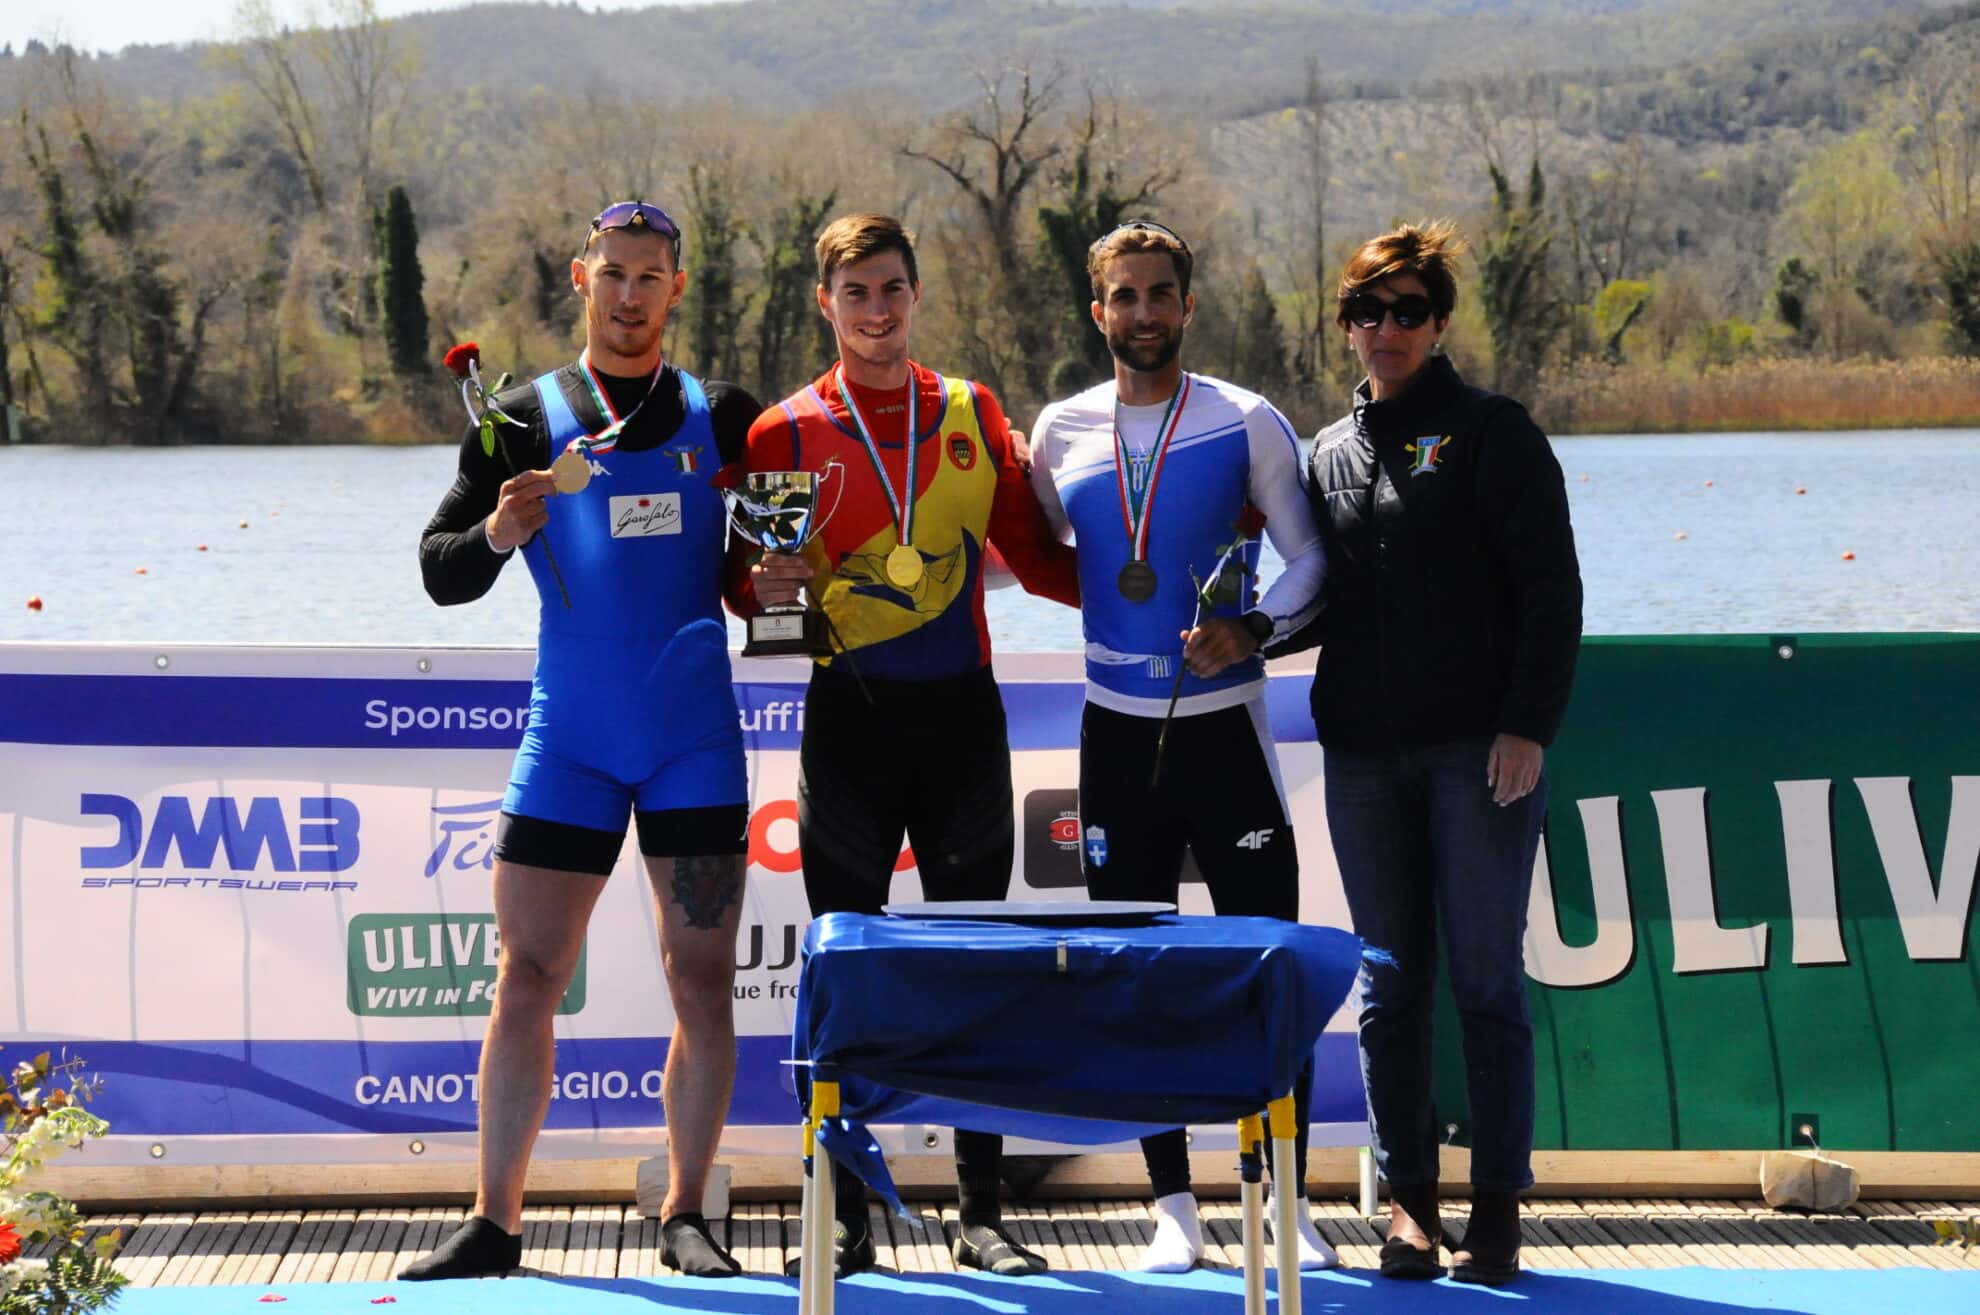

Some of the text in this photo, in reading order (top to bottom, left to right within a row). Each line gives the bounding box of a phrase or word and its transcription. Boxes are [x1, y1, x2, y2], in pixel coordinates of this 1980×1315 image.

[613, 502, 680, 536] Garofalo
[1236, 828, 1274, 849] 4F
[81, 877, 359, 892] SPORTSWEAR
[363, 923, 500, 973] ULIVE
[366, 986, 428, 1009] VIVI
